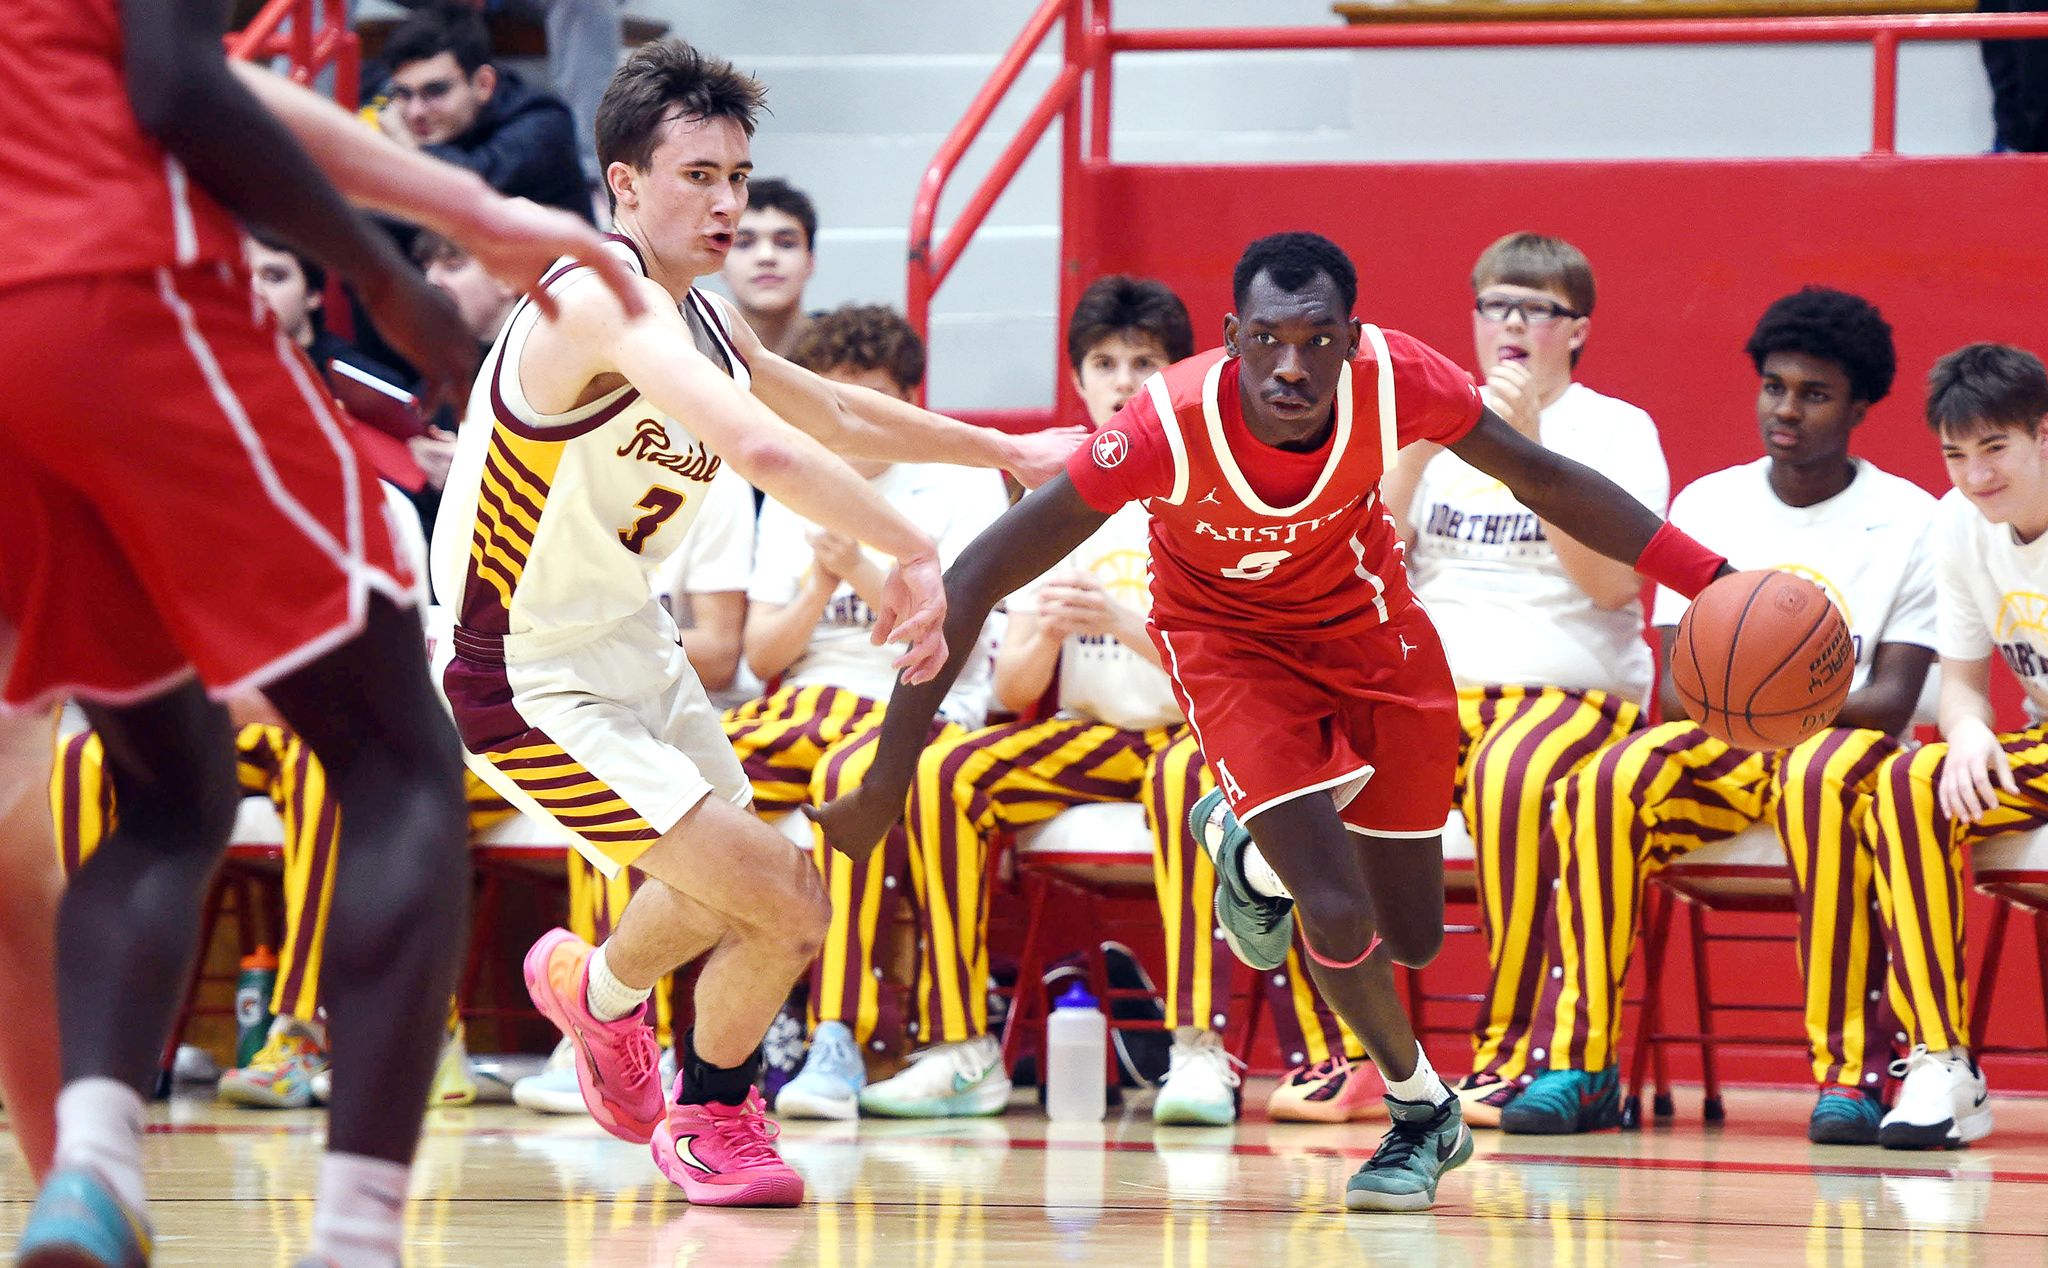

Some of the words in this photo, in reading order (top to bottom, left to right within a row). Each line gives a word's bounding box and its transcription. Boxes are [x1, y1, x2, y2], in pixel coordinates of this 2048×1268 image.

[617, 483, 687, 556] 3
[1426, 503, 1548, 544] NORTHFIEL
[1216, 757, 1247, 807] A
